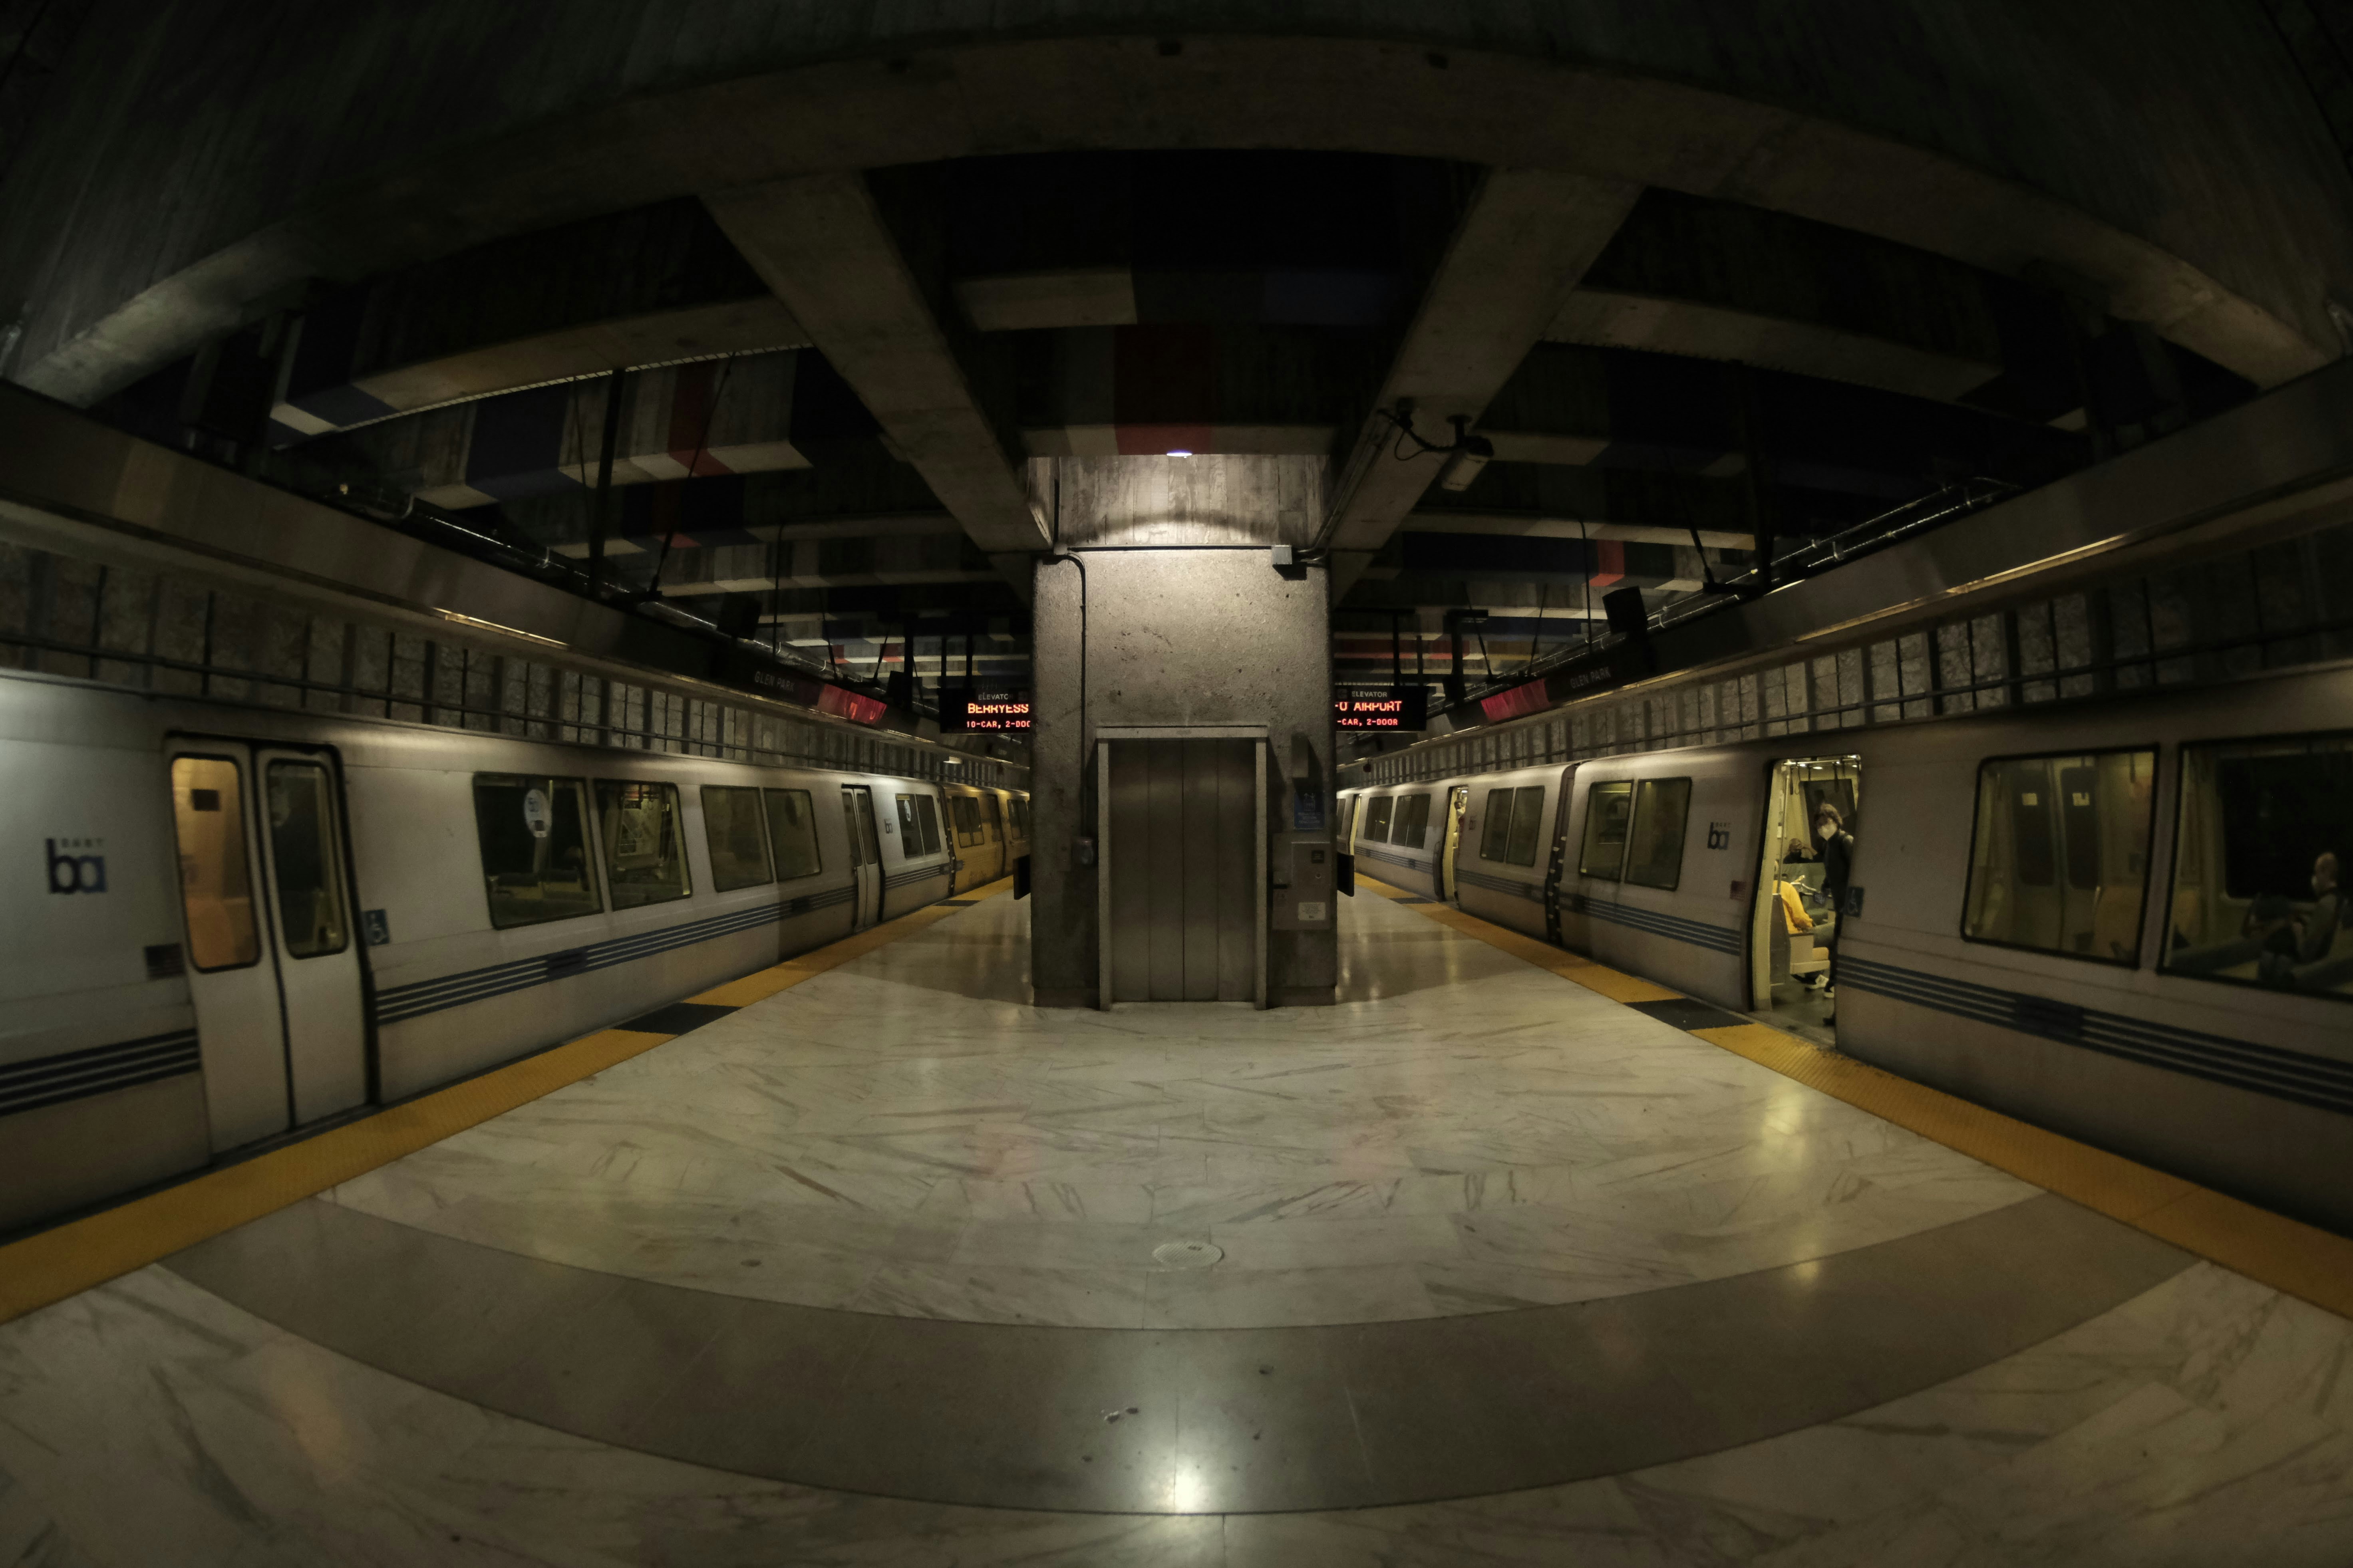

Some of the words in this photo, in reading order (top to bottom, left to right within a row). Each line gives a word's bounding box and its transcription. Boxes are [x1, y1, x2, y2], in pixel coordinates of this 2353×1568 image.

[755, 671, 775, 686] GLEN
[776, 678, 795, 692] PARK
[1570, 675, 1589, 688] GLEN
[1590, 666, 1611, 682] PARK
